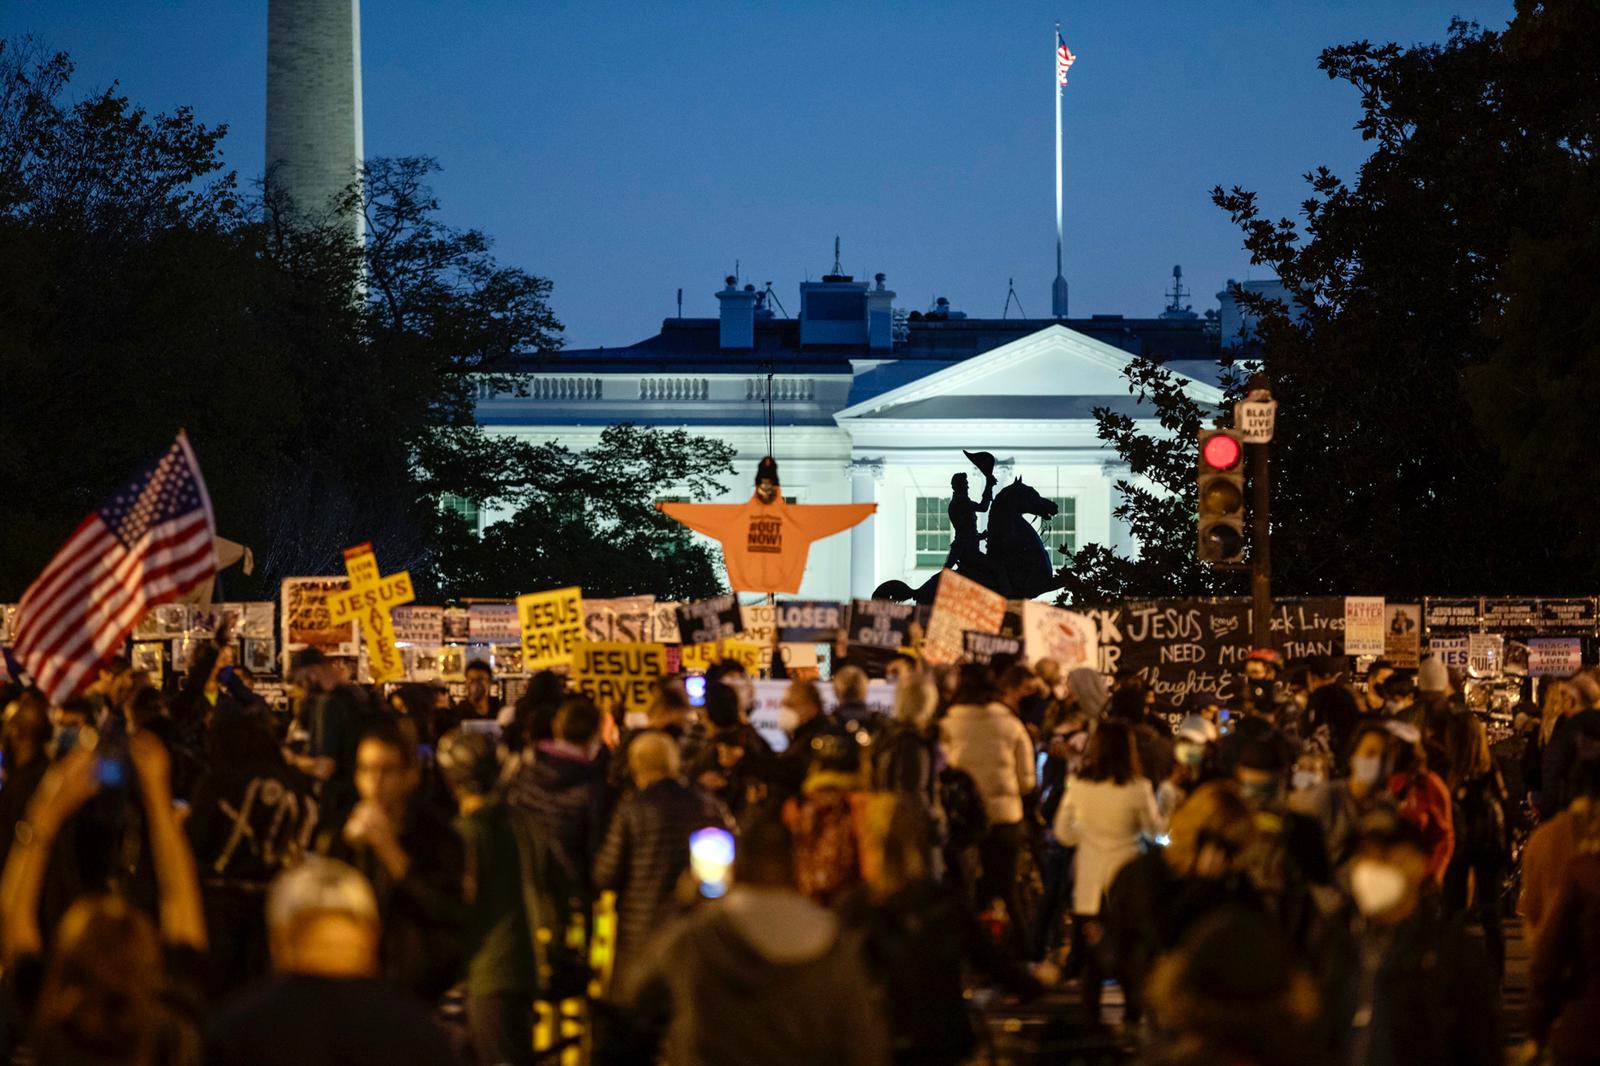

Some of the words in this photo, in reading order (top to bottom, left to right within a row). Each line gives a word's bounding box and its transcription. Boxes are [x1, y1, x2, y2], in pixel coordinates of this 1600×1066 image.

[1246, 409, 1272, 417] BLAC
[1249, 419, 1269, 427] LIVE
[748, 534, 782, 545] NOW!
[336, 579, 408, 616] JESUS
[397, 611, 439, 620] BLACK
[525, 599, 579, 630] JESUS
[777, 606, 839, 629] LOSER
[858, 601, 913, 619] TRUMP
[1347, 608, 1383, 617] MATTER
[402, 623, 435, 631] LIVES
[1127, 608, 1202, 642] JESUS
[1299, 607, 1346, 631] Lives
[859, 628, 904, 646] OVER
[966, 633, 1019, 656] TRUMP
[1432, 640, 1467, 648] BLUE
[1160, 643, 1206, 663] NEED
[1283, 641, 1332, 660] THAN
[580, 651, 660, 676] JESUS
